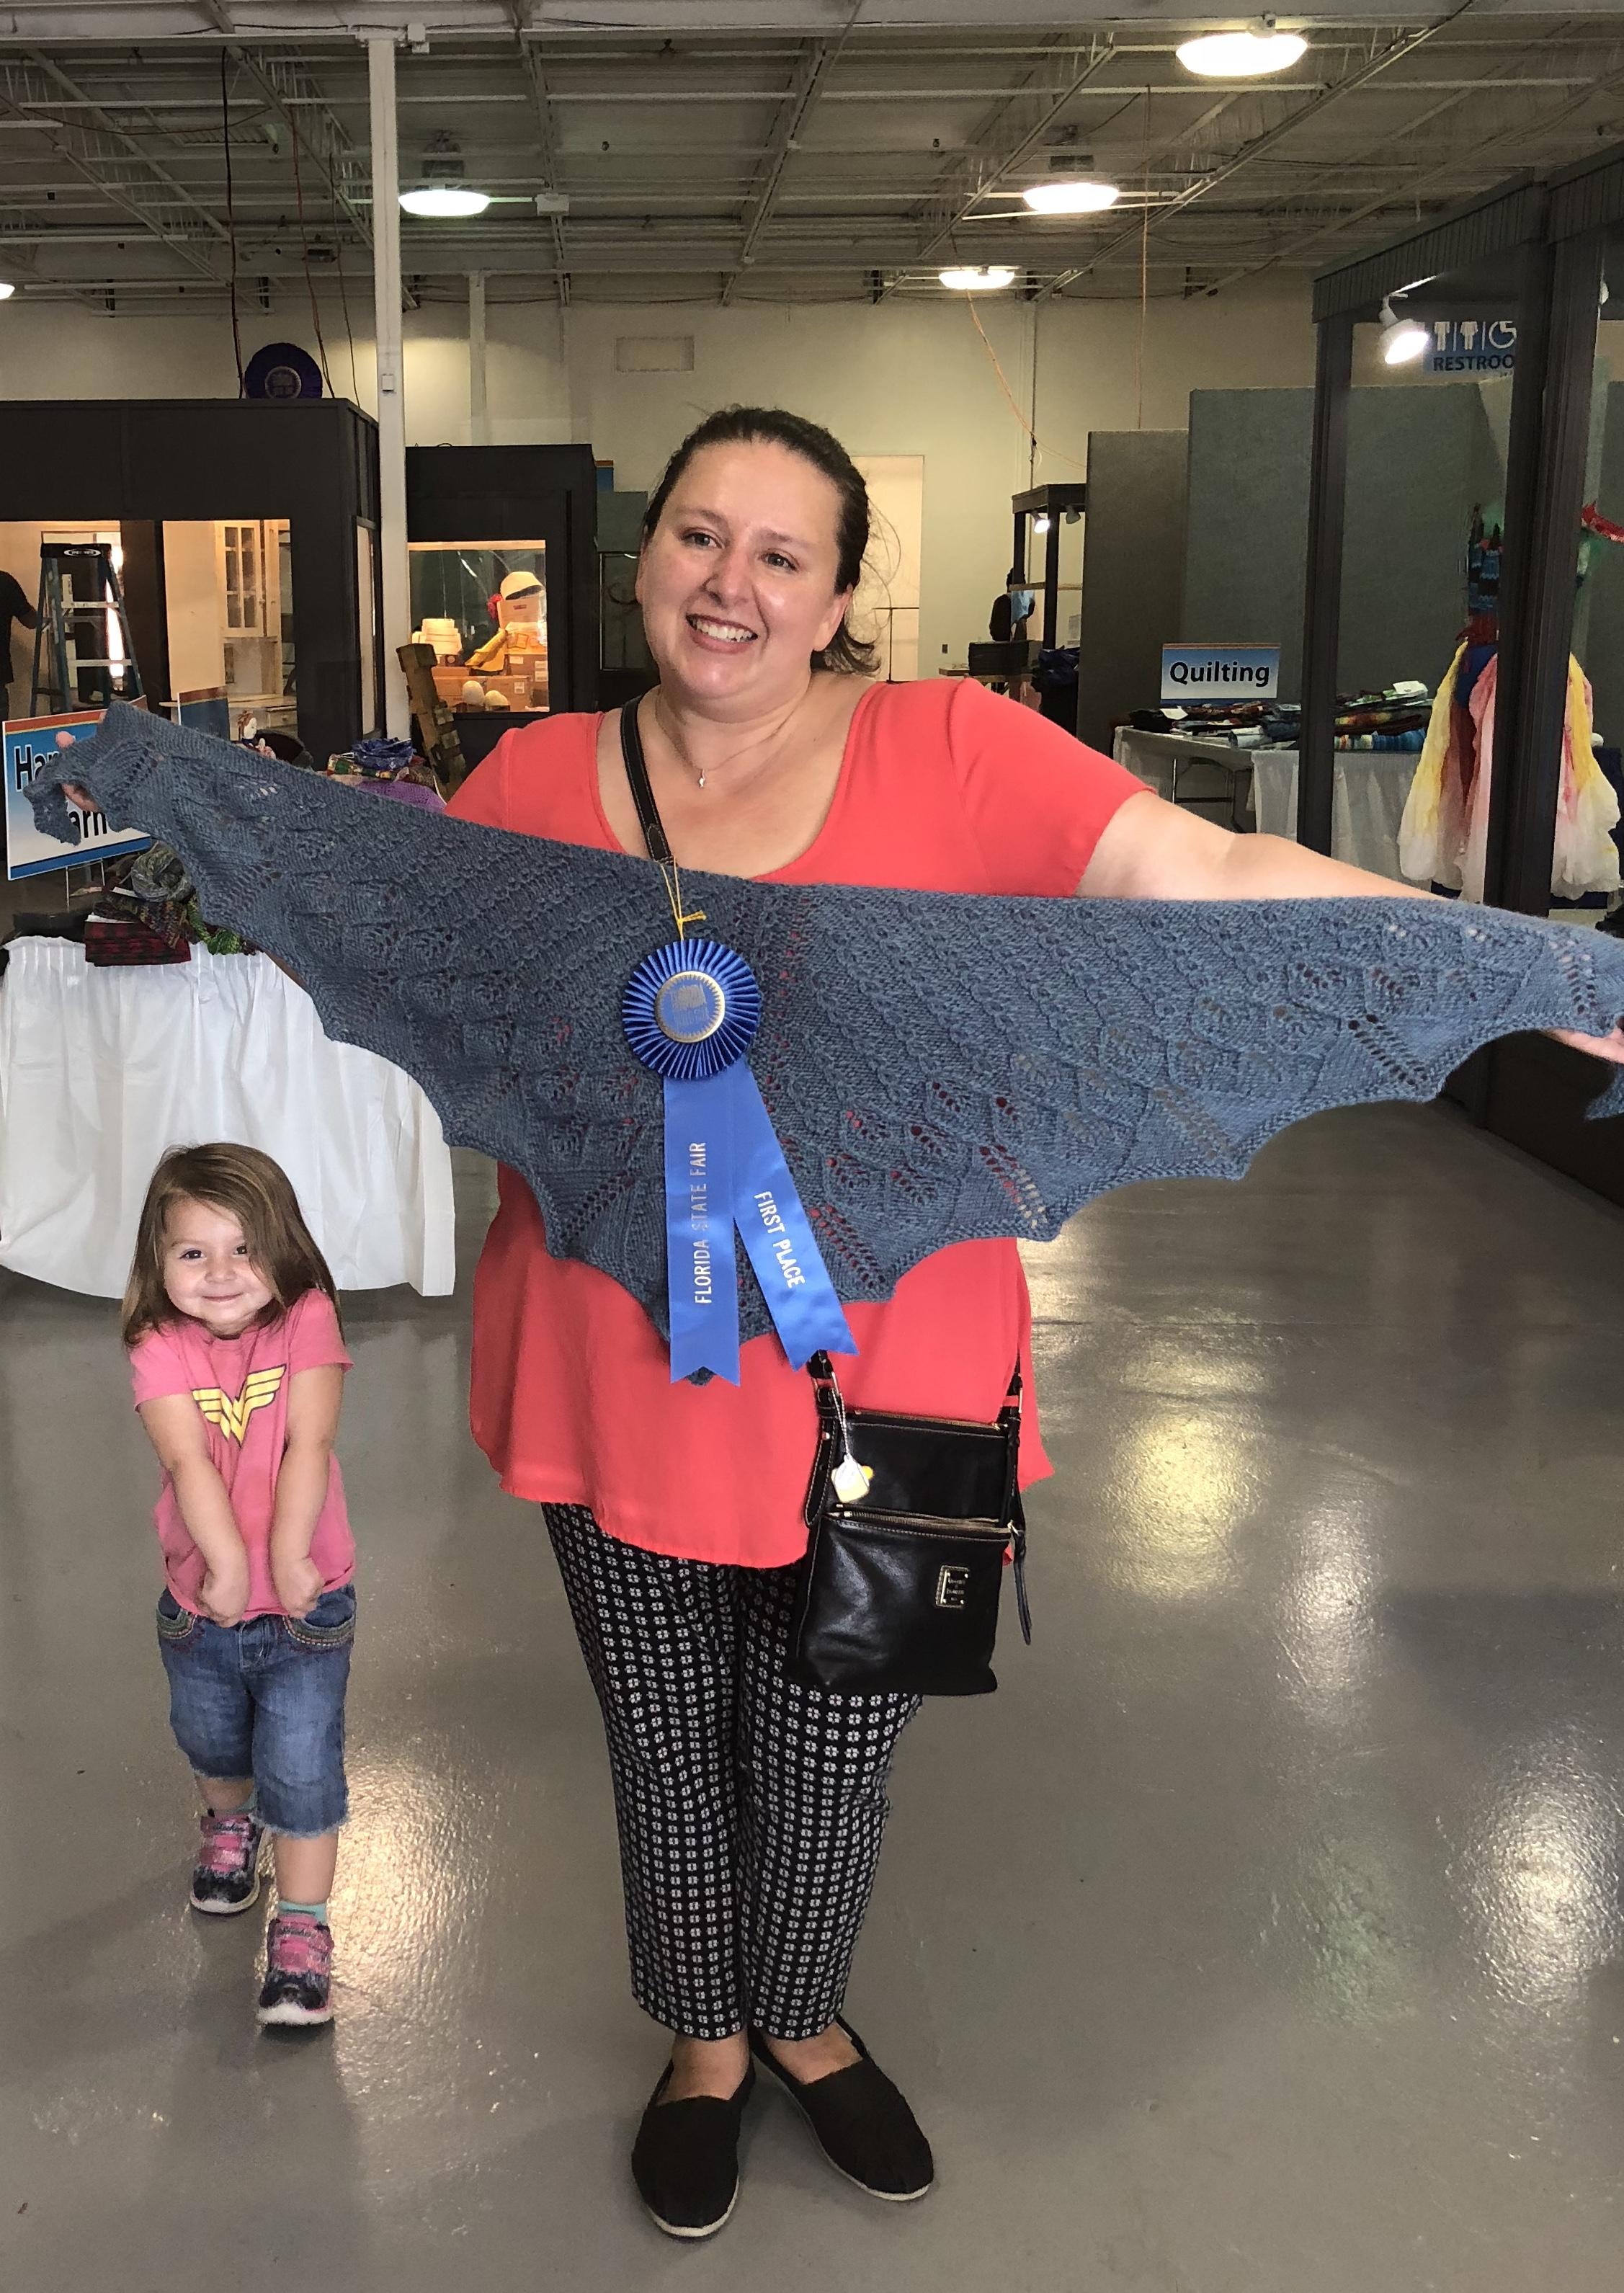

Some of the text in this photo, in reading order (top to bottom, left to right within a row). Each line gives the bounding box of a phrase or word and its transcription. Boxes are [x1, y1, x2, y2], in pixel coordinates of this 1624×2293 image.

[1433, 354, 1514, 371] RESTROO
[1169, 660, 1270, 687] Quilting
[689, 1141, 713, 1304] FLORIDA STATE FAIR
[754, 1190, 806, 1289] FIRST PLACE
